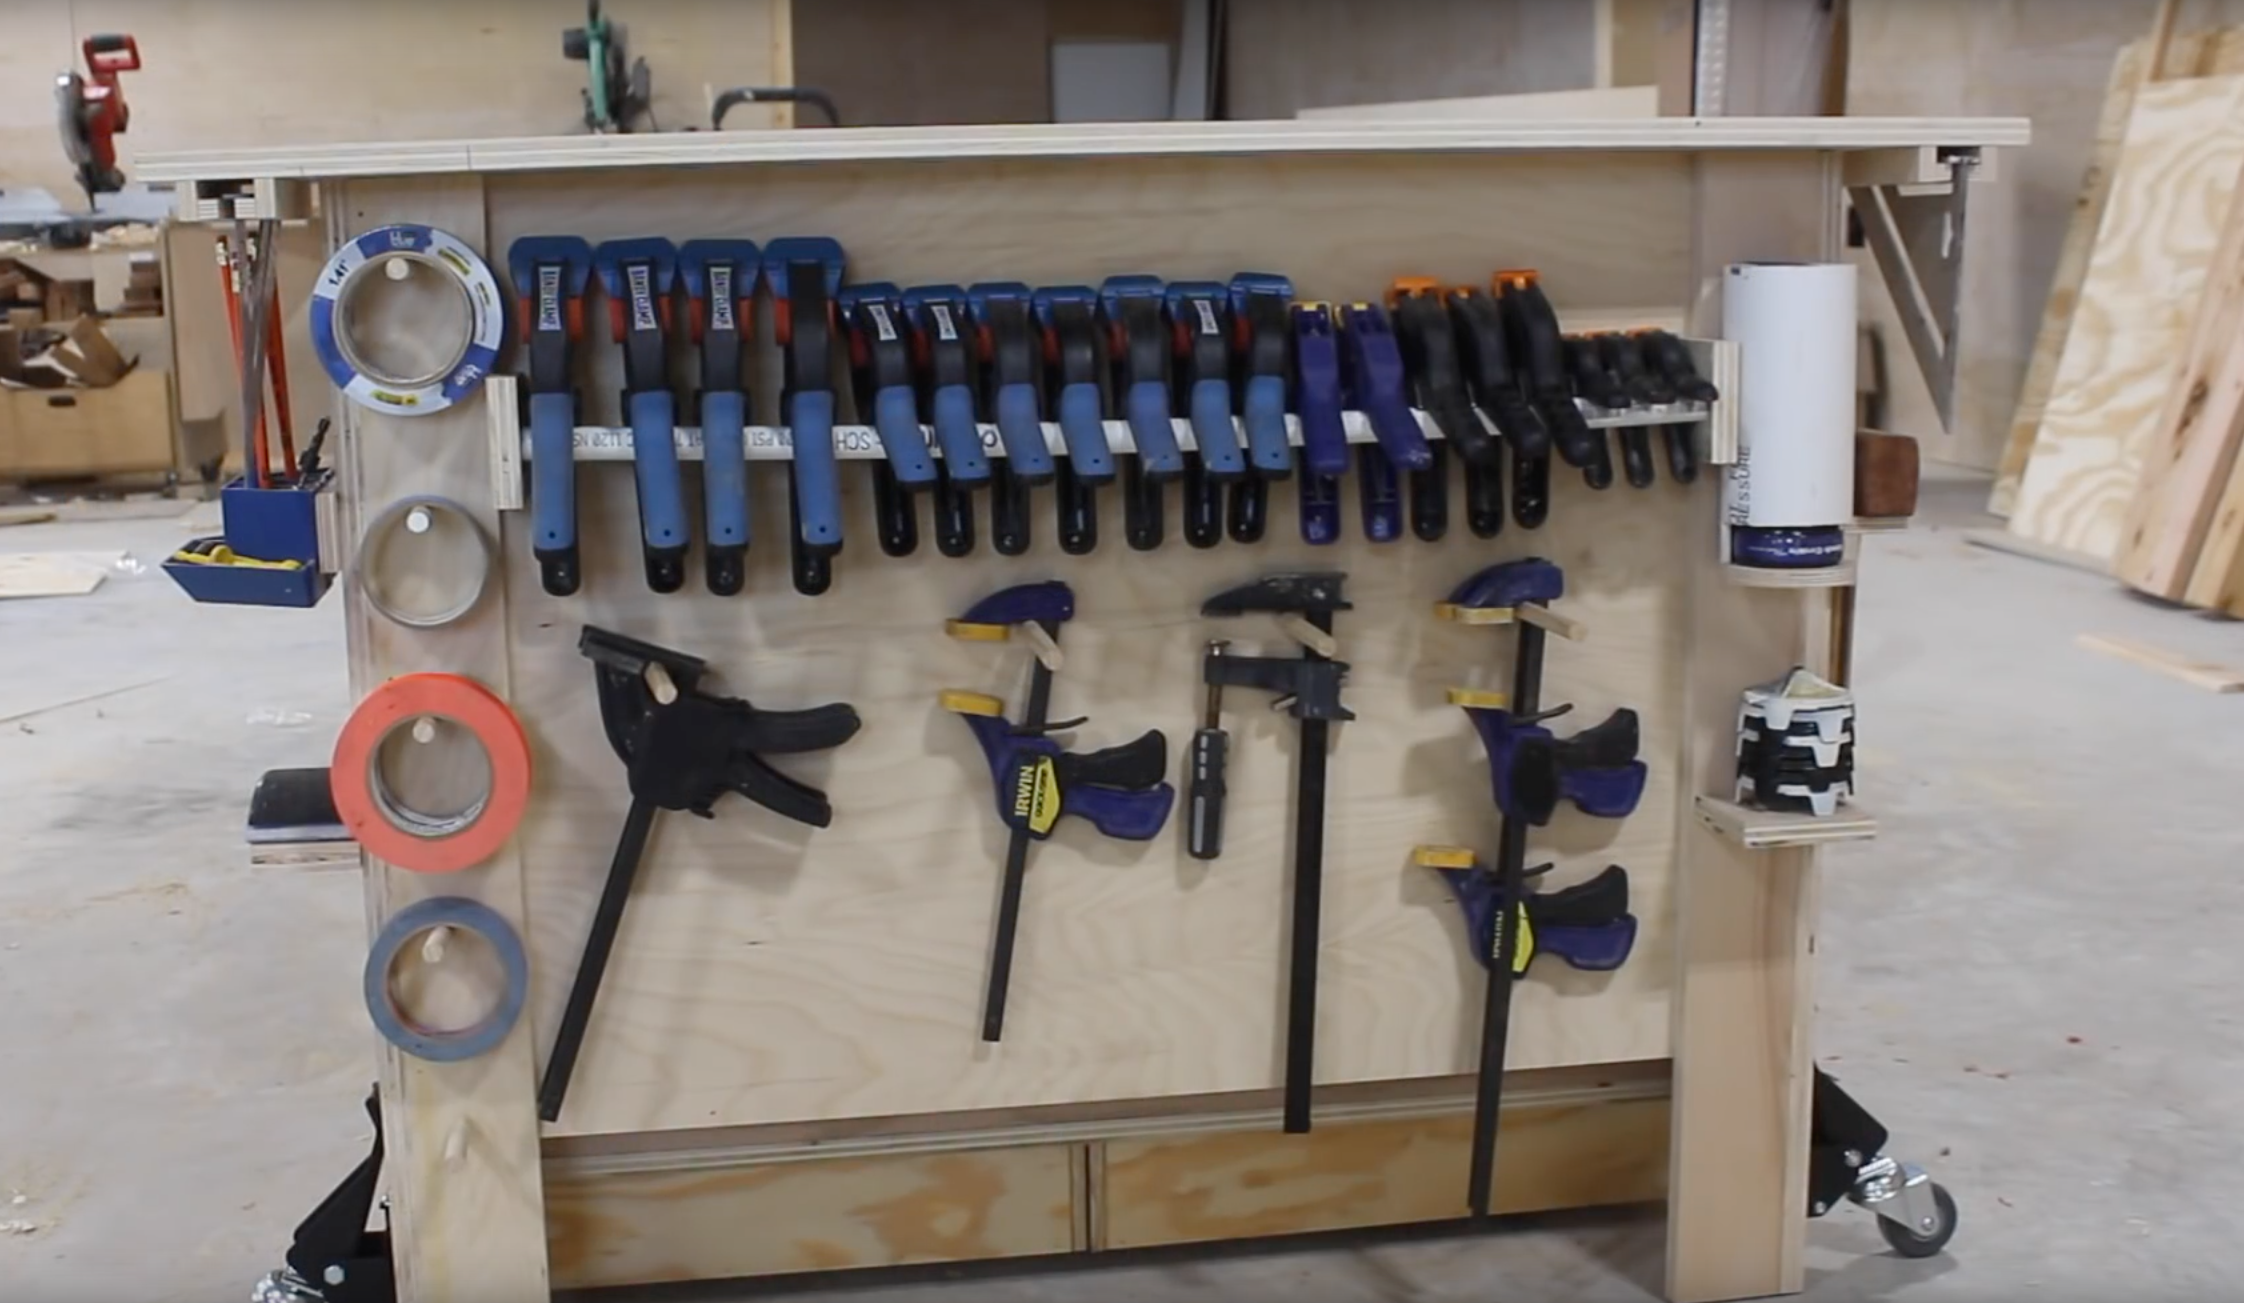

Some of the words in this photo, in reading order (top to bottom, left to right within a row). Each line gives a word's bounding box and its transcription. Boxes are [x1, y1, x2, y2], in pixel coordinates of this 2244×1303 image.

[593, 433, 622, 448] 1120
[836, 431, 871, 451] SCH
[1014, 766, 1034, 817] IRWIN
